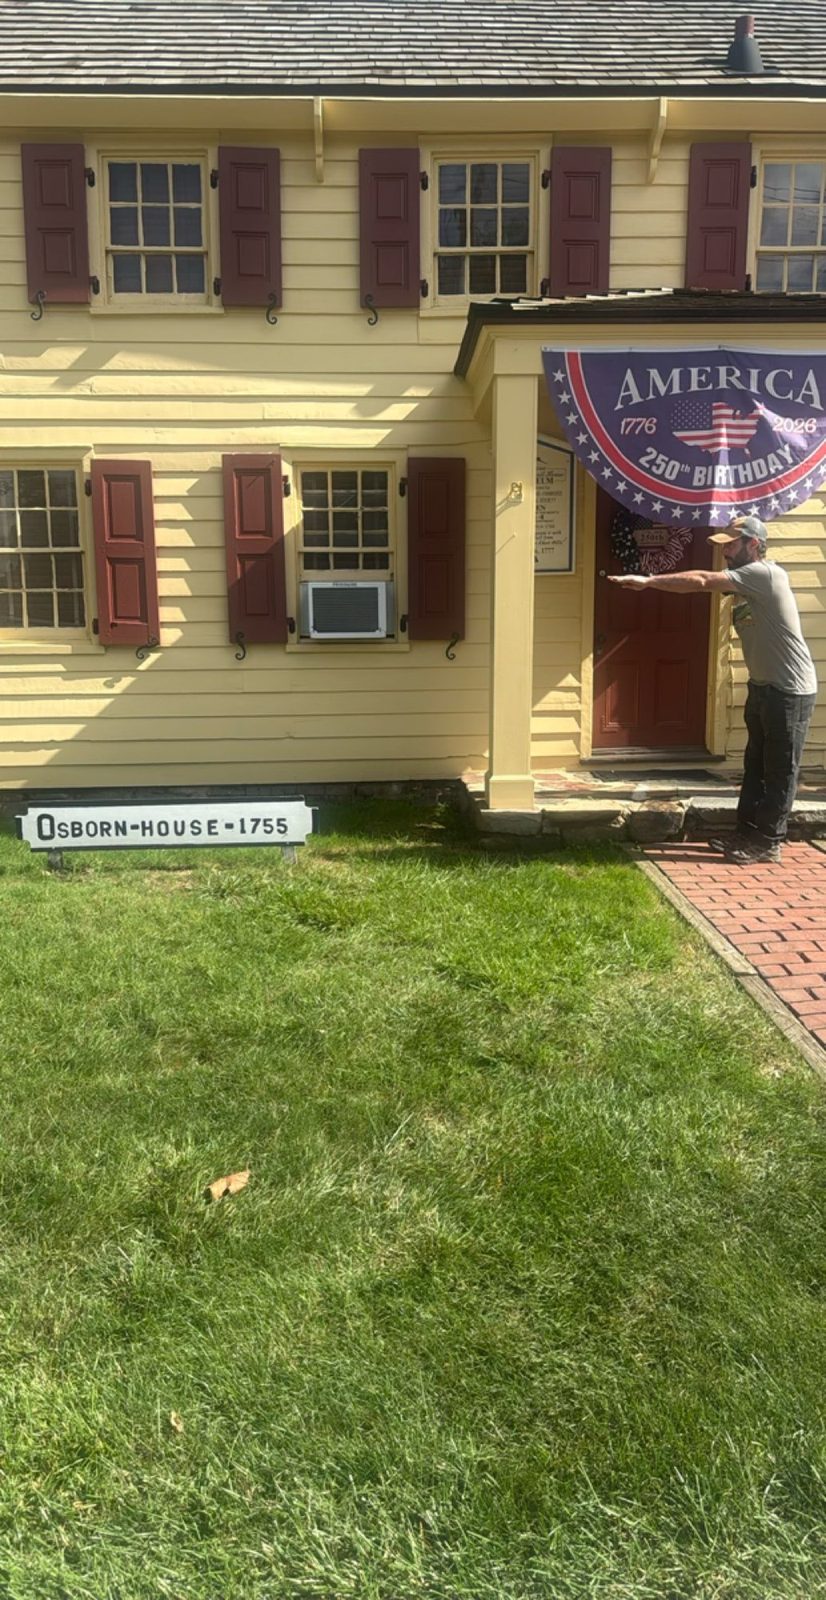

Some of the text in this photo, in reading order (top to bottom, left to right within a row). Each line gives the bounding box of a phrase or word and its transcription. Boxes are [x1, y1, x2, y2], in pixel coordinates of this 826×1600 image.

[614, 365, 825, 411] AMERICA
[620, 417, 657, 435] 1776
[772, 417, 817, 434] 2026
[639, 443, 795, 487] 250th BIRTHDAY
